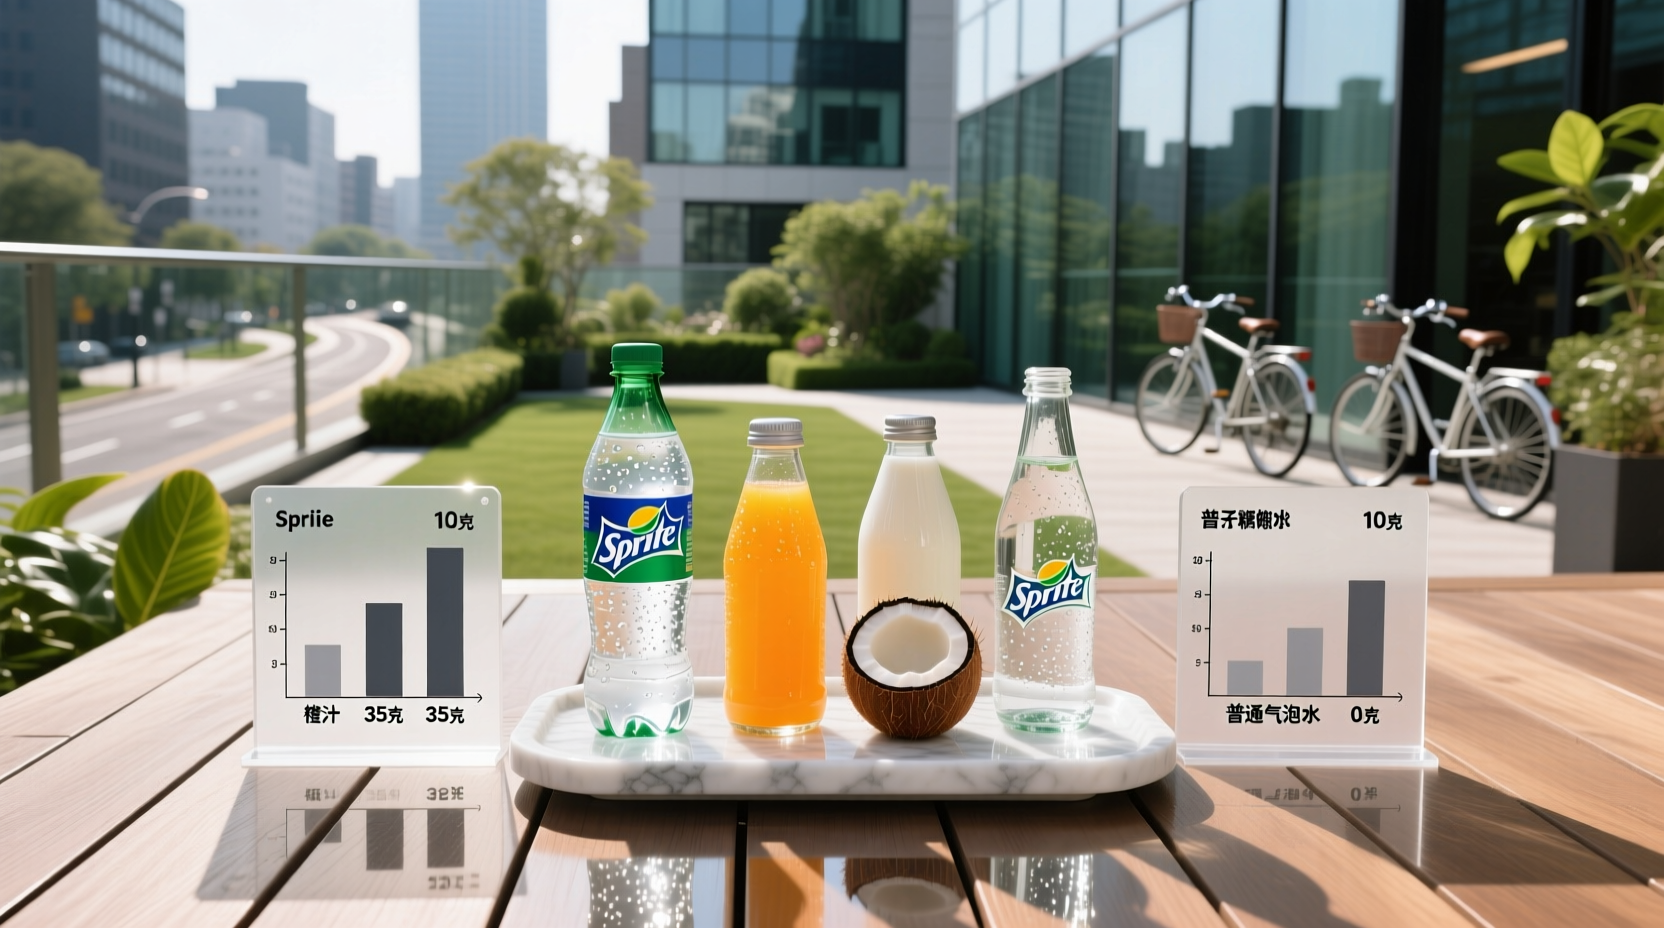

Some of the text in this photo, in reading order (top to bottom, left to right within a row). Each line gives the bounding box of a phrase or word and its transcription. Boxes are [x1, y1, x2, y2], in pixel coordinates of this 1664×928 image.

[434, 511, 475, 531] 10克
[1363, 511, 1403, 531] 10克
[599, 516, 676, 570] Sprite
[1009, 568, 1084, 618] Sprite
[364, 705, 404, 725] 35克
[425, 705, 465, 725] 35克
[1226, 703, 1321, 725] 普通气泡水
[1350, 705, 1380, 725] 0克
